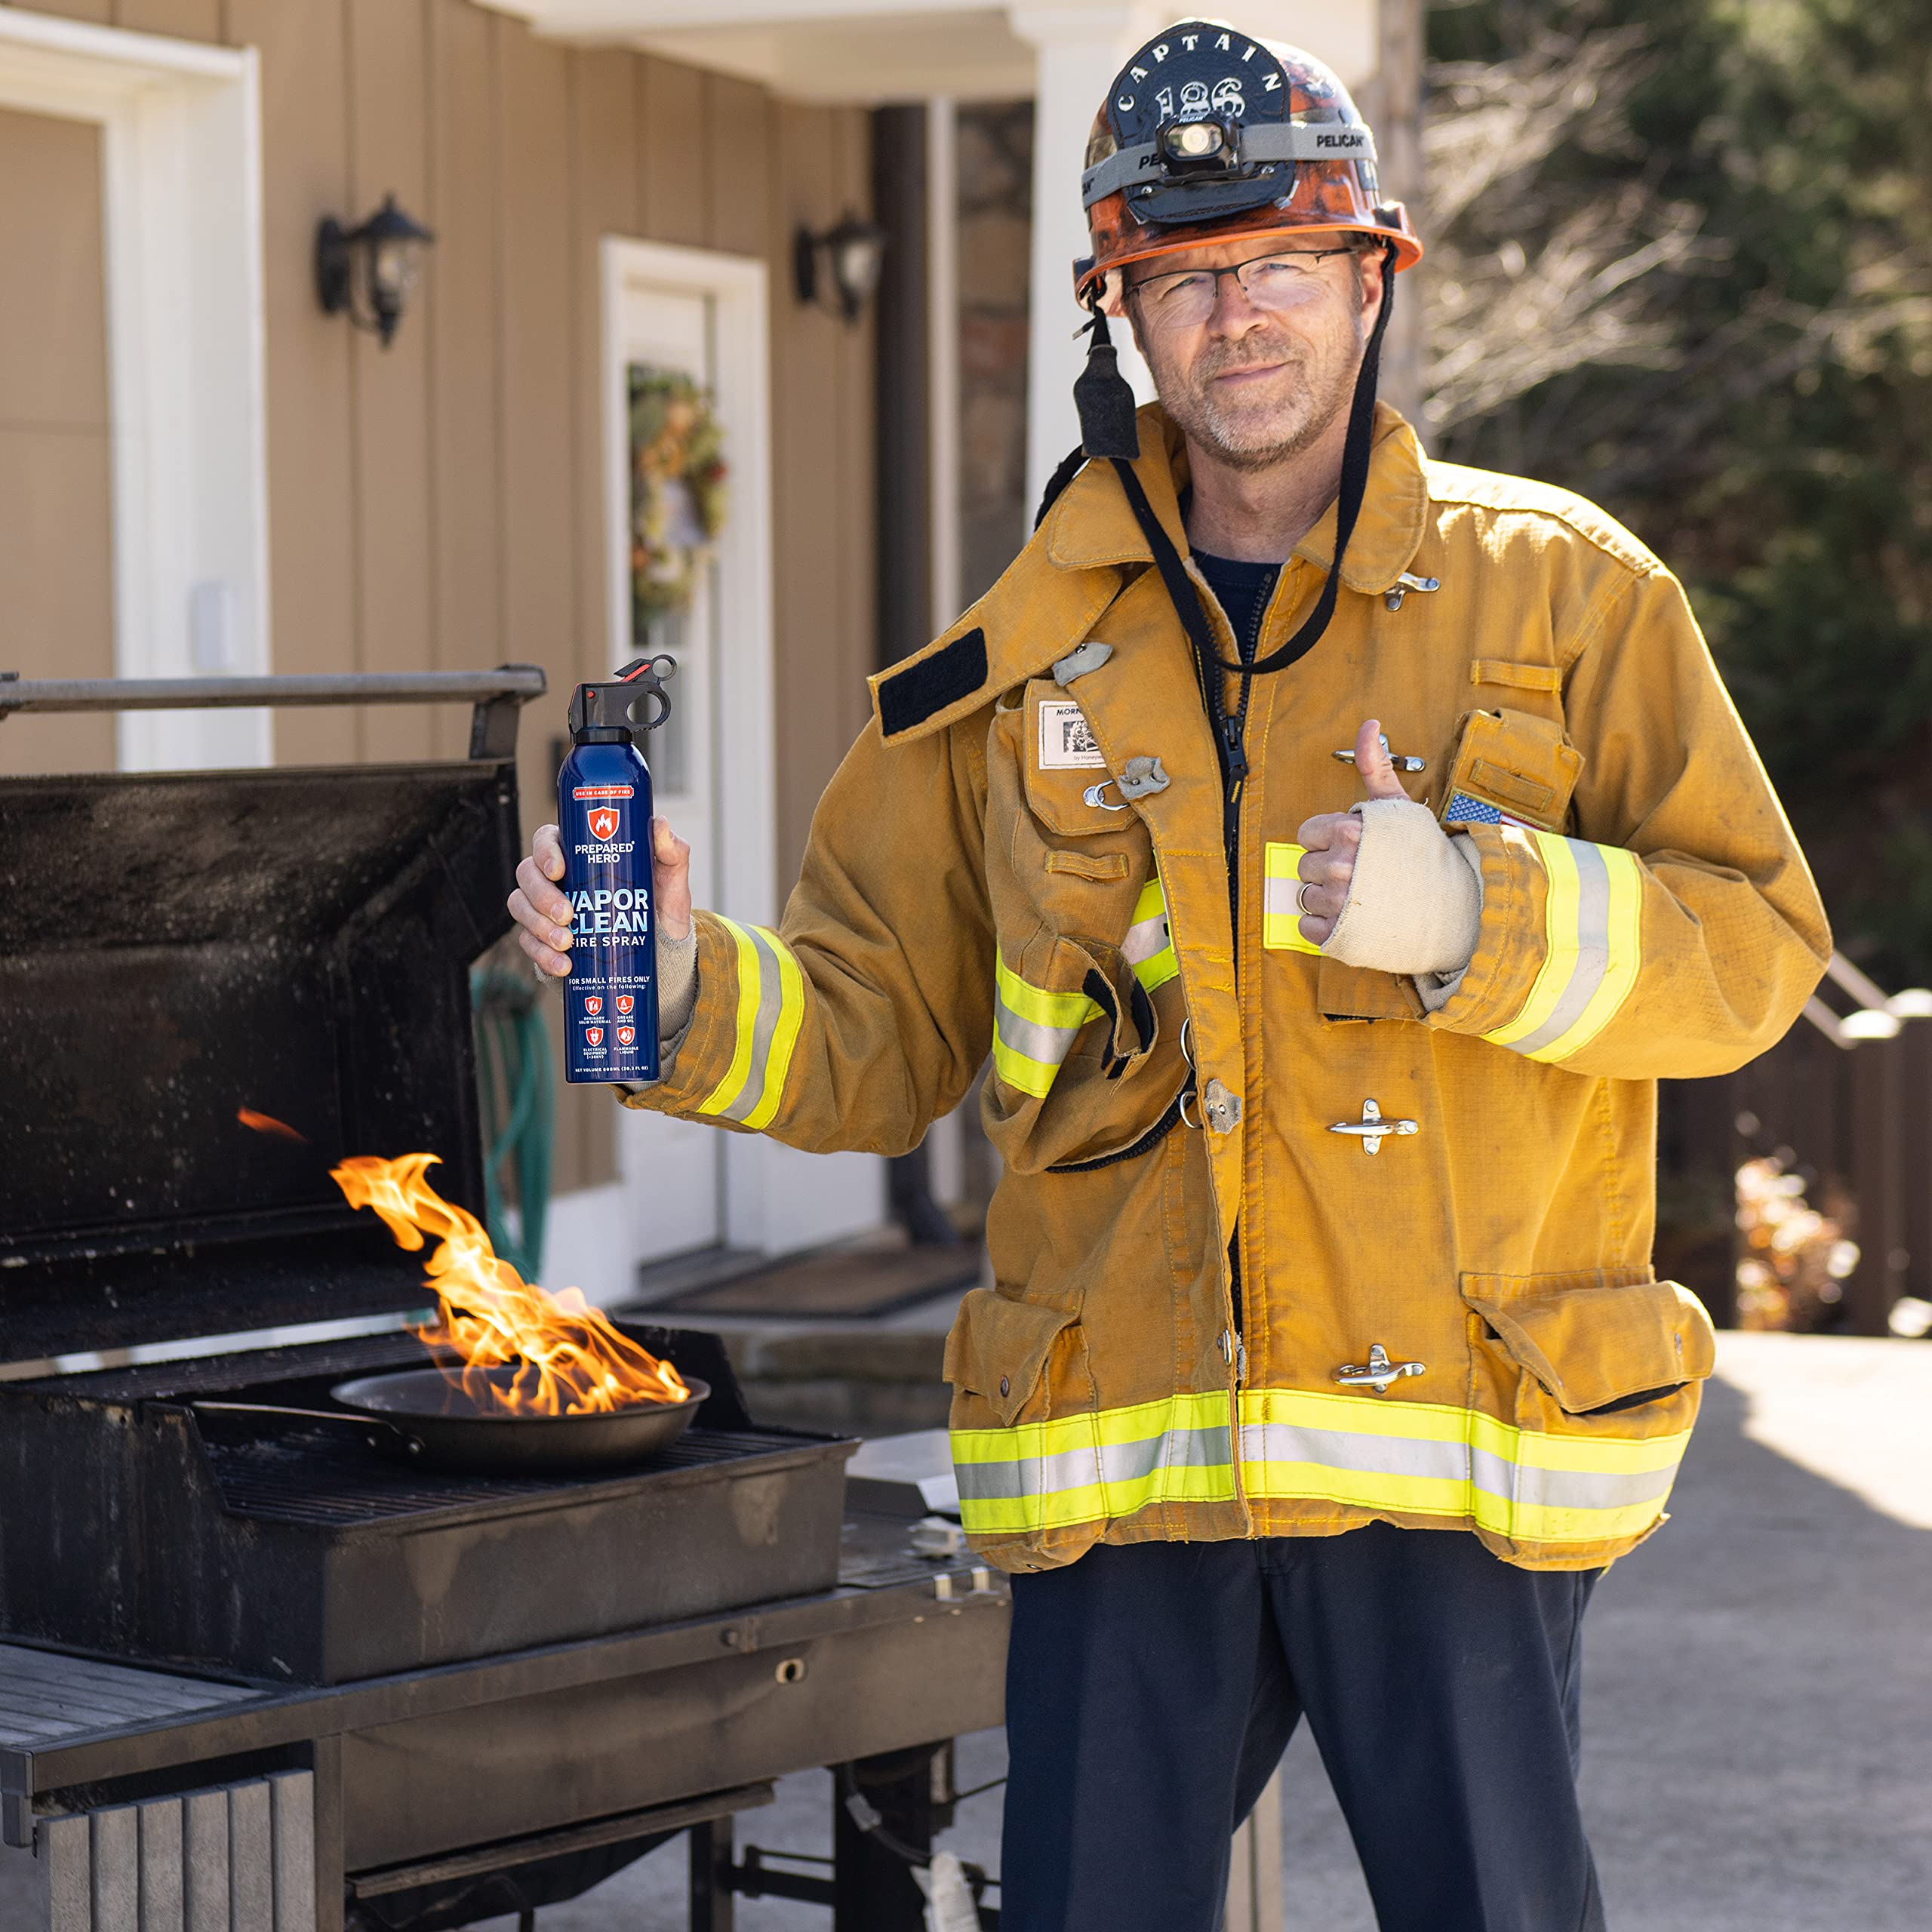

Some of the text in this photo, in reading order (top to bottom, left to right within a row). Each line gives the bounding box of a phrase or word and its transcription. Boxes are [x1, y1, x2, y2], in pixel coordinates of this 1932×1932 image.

[1118, 33, 1282, 112] CAPTAIN
[1155, 77, 1245, 122] 186
[1316, 134, 1363, 148] PELICAN
[575, 843, 634, 854] PREPARED
[588, 854, 620, 863] HERO
[602, 936, 646, 946] SPRAY
